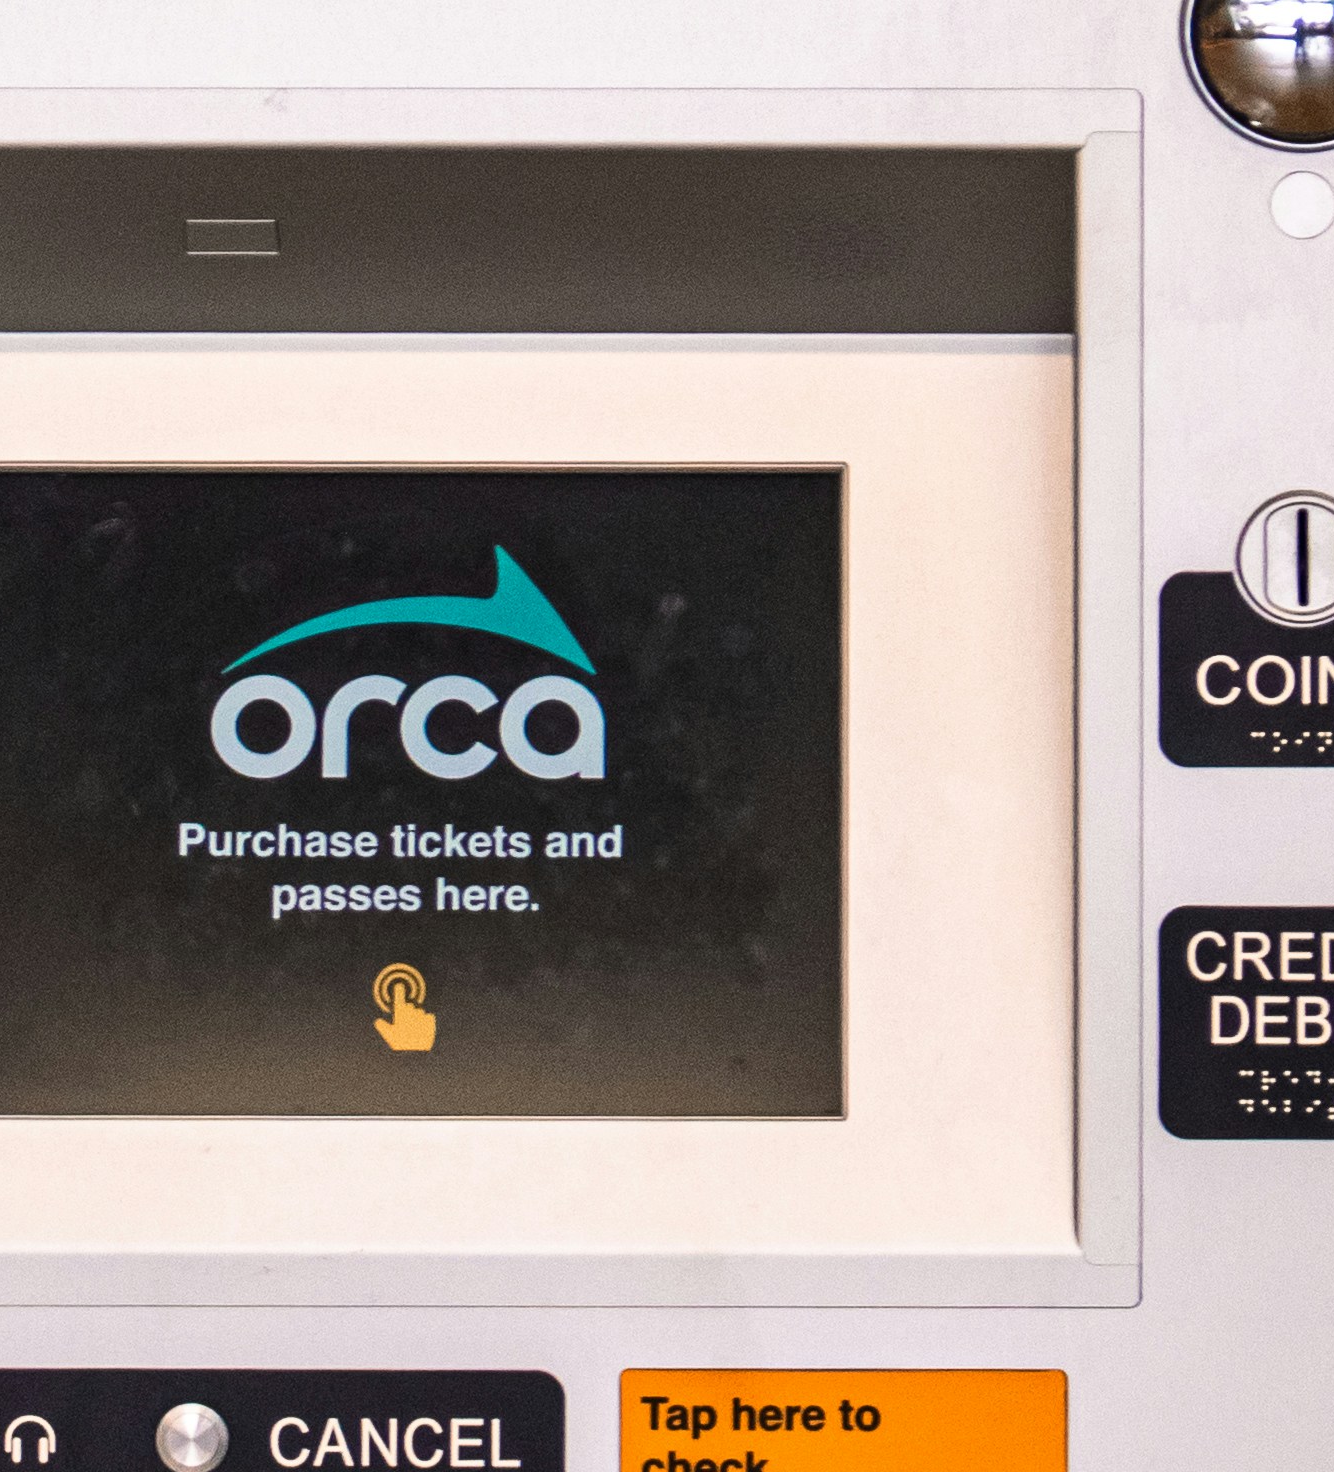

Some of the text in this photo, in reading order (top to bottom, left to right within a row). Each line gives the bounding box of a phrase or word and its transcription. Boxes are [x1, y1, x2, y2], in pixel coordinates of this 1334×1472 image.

[211, 671, 604, 779] orca
[179, 823, 622, 858] Purchase tickets and
[273, 877, 539, 919] passes here.
[641, 1397, 881, 1442] Tap here to
[270, 1417, 521, 1468] CANCEL
